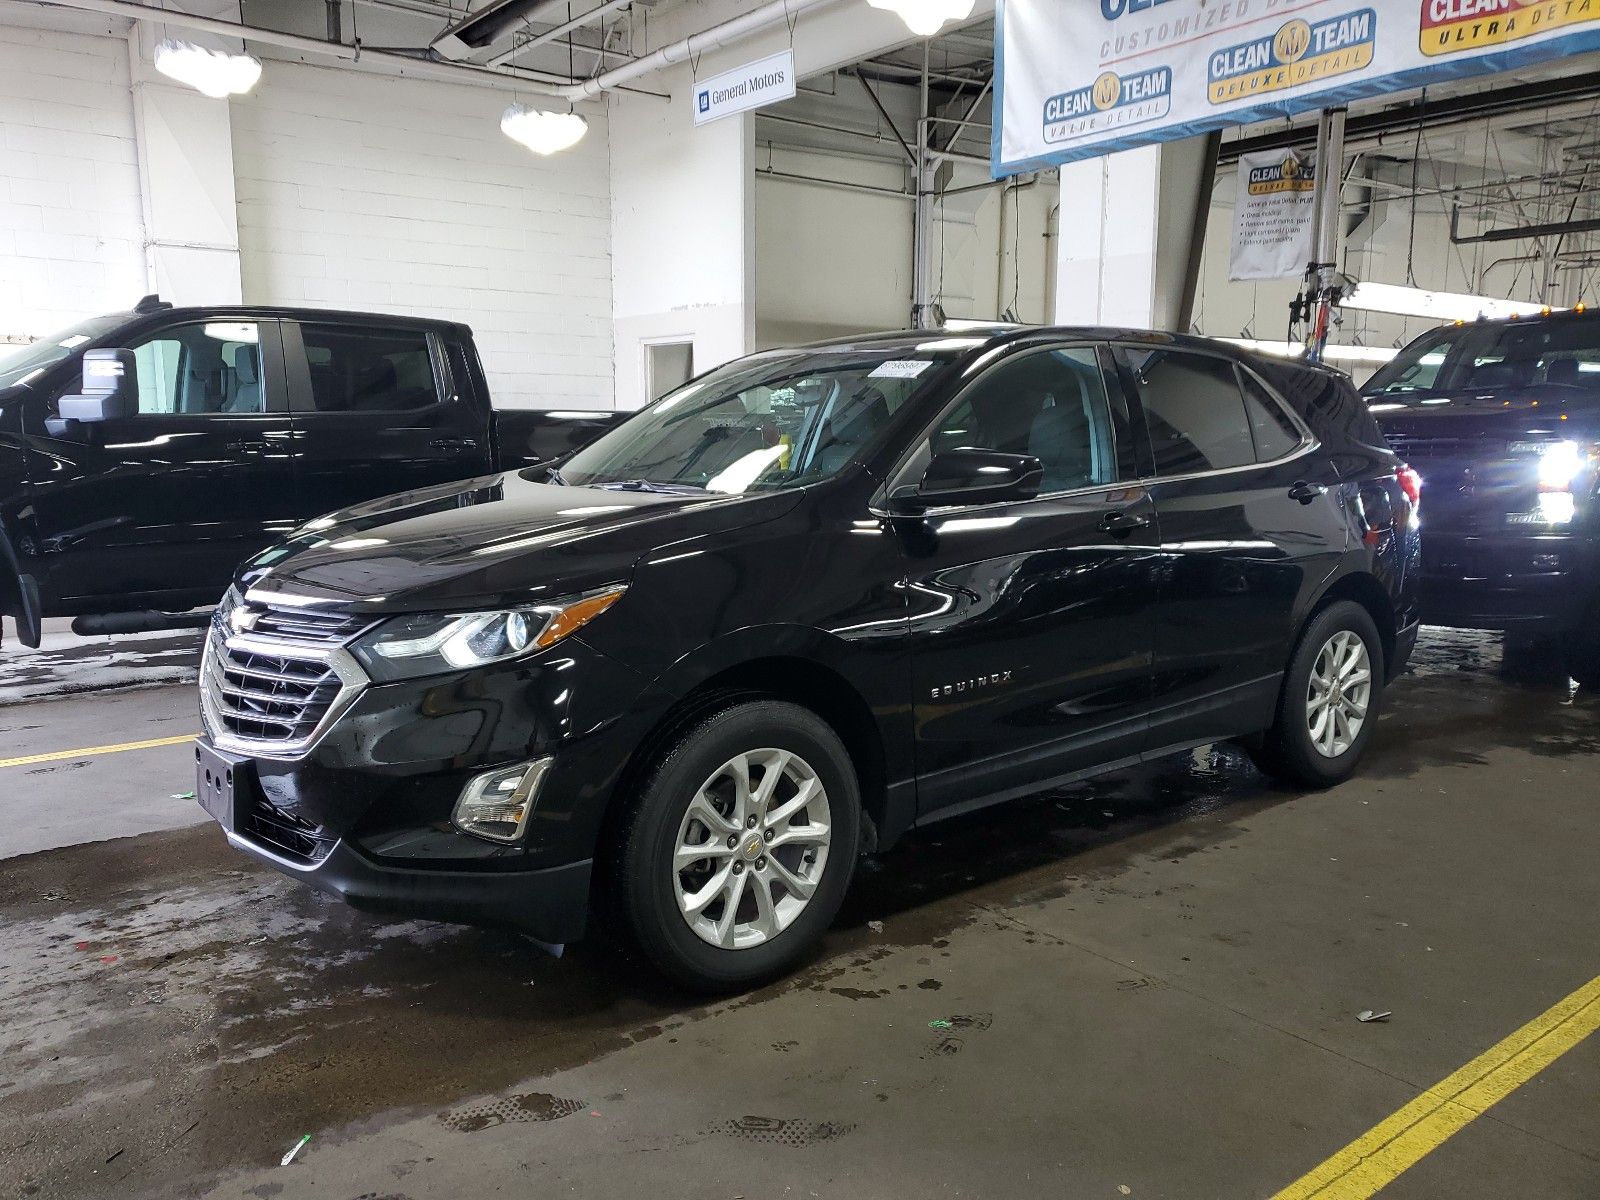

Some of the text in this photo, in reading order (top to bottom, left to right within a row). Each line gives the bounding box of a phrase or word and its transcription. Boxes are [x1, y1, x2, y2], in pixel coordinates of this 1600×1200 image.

[1099, 0, 1249, 58] CUSTOMIZED
[1439, 0, 1600, 45] ULTRA DETA
[1212, 40, 1271, 79] CLEAN
[1313, 12, 1370, 52] TEAM
[712, 80, 747, 105] General
[749, 70, 785, 93] Motors
[1046, 90, 1092, 121] CLEAN
[1122, 69, 1167, 101] TEAM
[1216, 50, 1361, 98] DELUXE DETAIL
[1051, 101, 1160, 138] VALUE DETAIL
[1251, 166, 1281, 182] CLEAN
[931, 670, 1012, 698] EQUINOX
